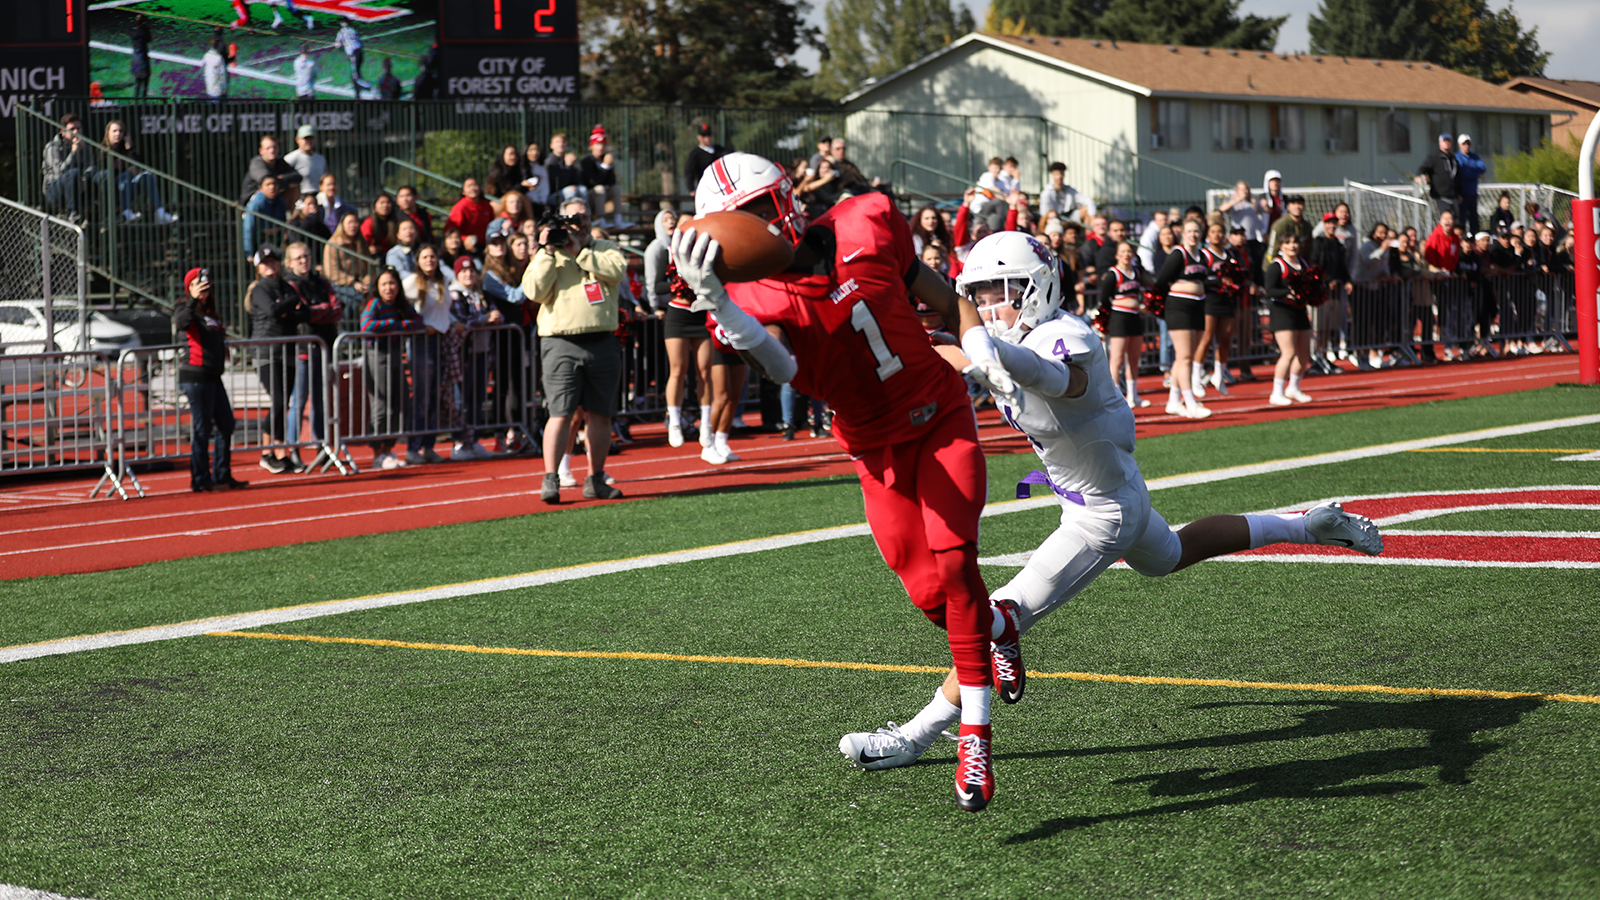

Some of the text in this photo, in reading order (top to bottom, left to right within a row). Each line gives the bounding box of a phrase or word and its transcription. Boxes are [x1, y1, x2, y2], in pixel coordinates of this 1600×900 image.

[478, 57, 546, 75] CITY OF
[0, 66, 65, 91] NICH
[448, 75, 576, 95] FOREST GROVE
[140, 115, 202, 134] HOME
[206, 113, 234, 133] OF
[237, 113, 276, 132] THE
[851, 299, 904, 382] 1
[1052, 338, 1072, 363] 4
